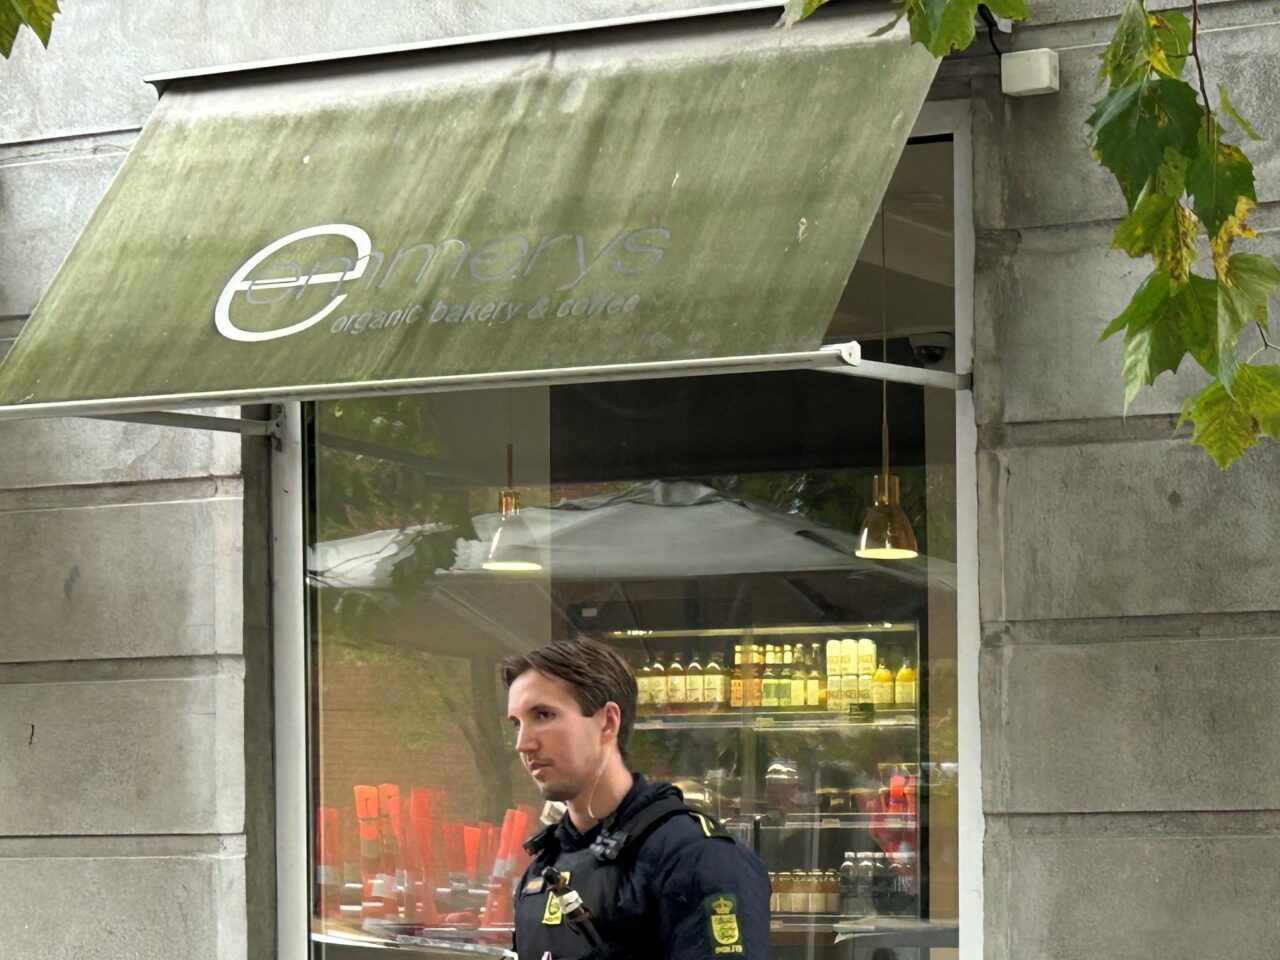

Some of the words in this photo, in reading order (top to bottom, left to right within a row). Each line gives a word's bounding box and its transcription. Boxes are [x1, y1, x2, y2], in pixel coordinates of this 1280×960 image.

[330, 301, 422, 335] organic
[428, 299, 520, 325] bakery
[527, 298, 550, 320] &
